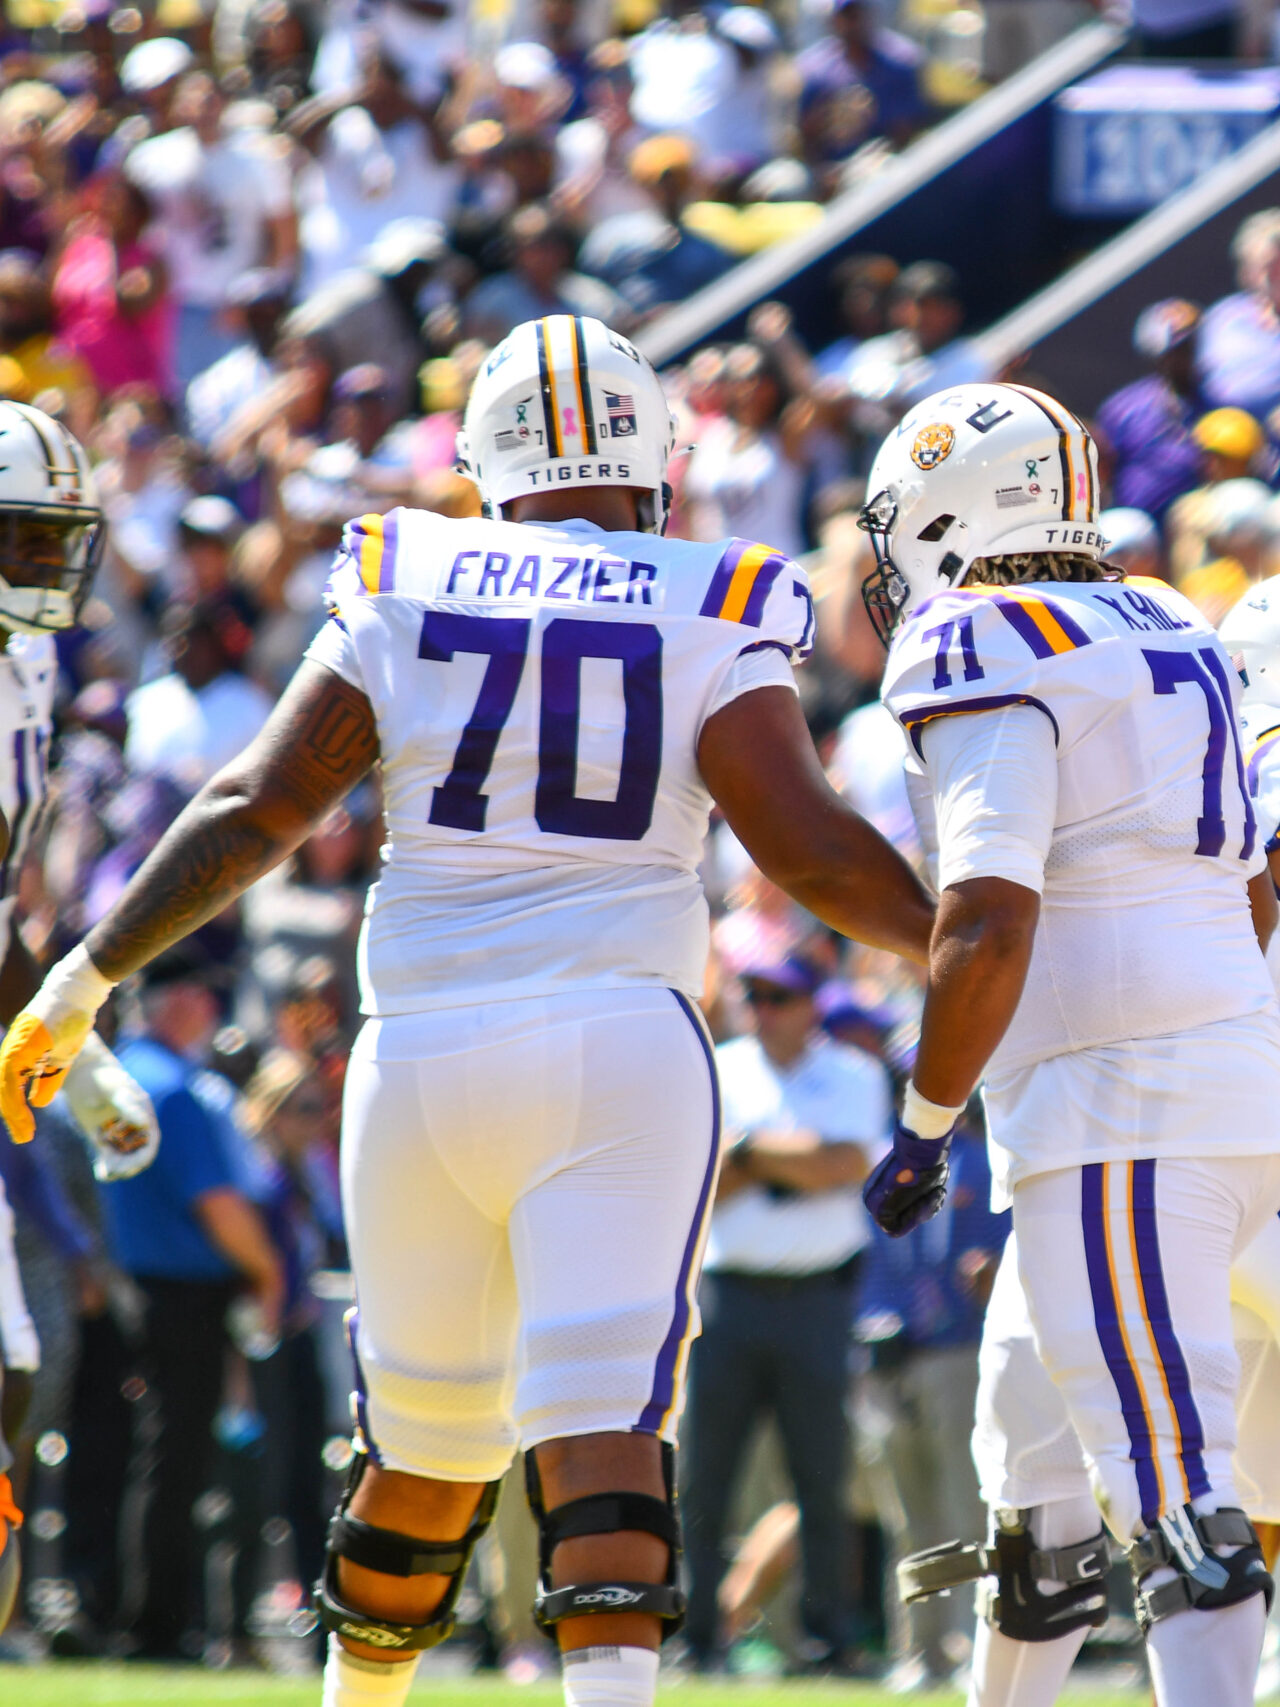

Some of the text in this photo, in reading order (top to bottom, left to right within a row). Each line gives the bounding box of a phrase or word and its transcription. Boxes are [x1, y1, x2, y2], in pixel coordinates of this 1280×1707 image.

[528, 464, 631, 485] TIGERS
[1050, 488, 1058, 505] 7
[446, 551, 659, 605] FRAZIER
[922, 615, 985, 691] 71
[418, 611, 664, 841] 70
[1140, 647, 1257, 861] 71
